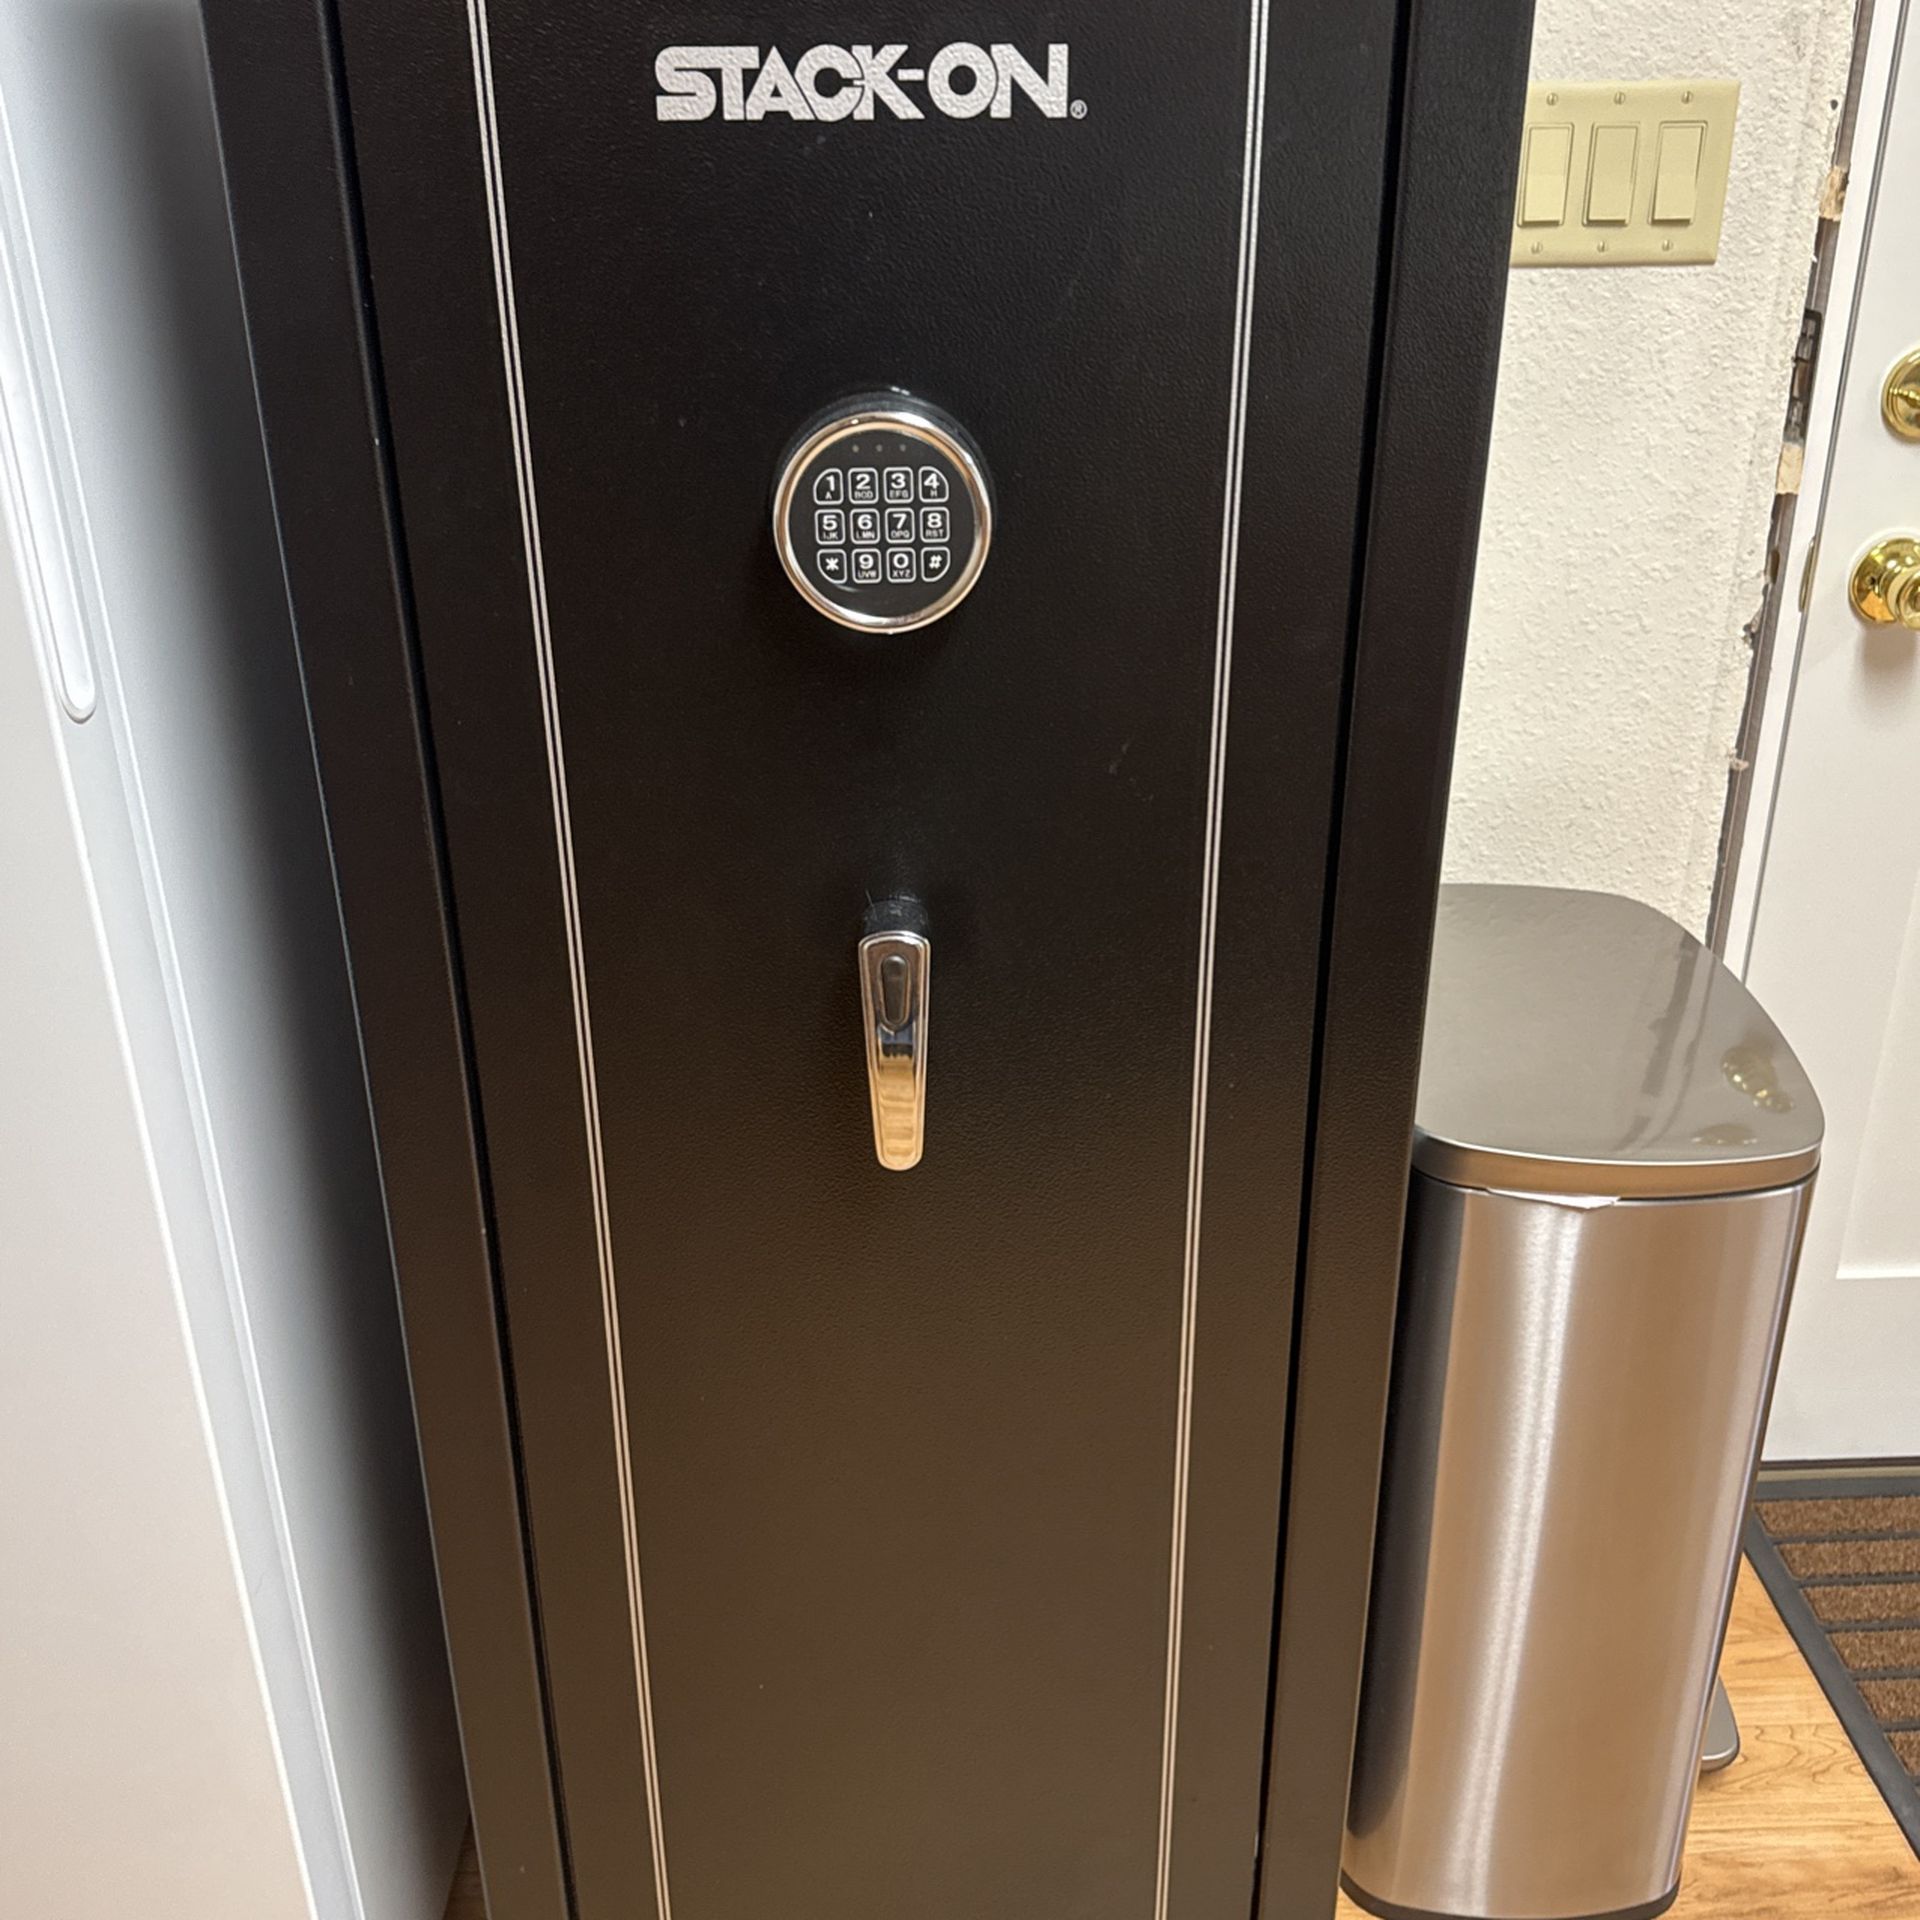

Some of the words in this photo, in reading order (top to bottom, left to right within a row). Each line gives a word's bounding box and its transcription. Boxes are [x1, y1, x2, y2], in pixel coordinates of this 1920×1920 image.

[826, 475, 835, 491] 1
[856, 474, 871, 489] 2
[891, 473, 906, 489] 3
[924, 473, 939, 488] 4
[823, 515, 838, 530] 5
[858, 514, 872, 530] 6
[892, 514, 907, 529] 7
[927, 513, 942, 528] 8
[859, 554, 874, 569] 9
[893, 553, 908, 568] 0
